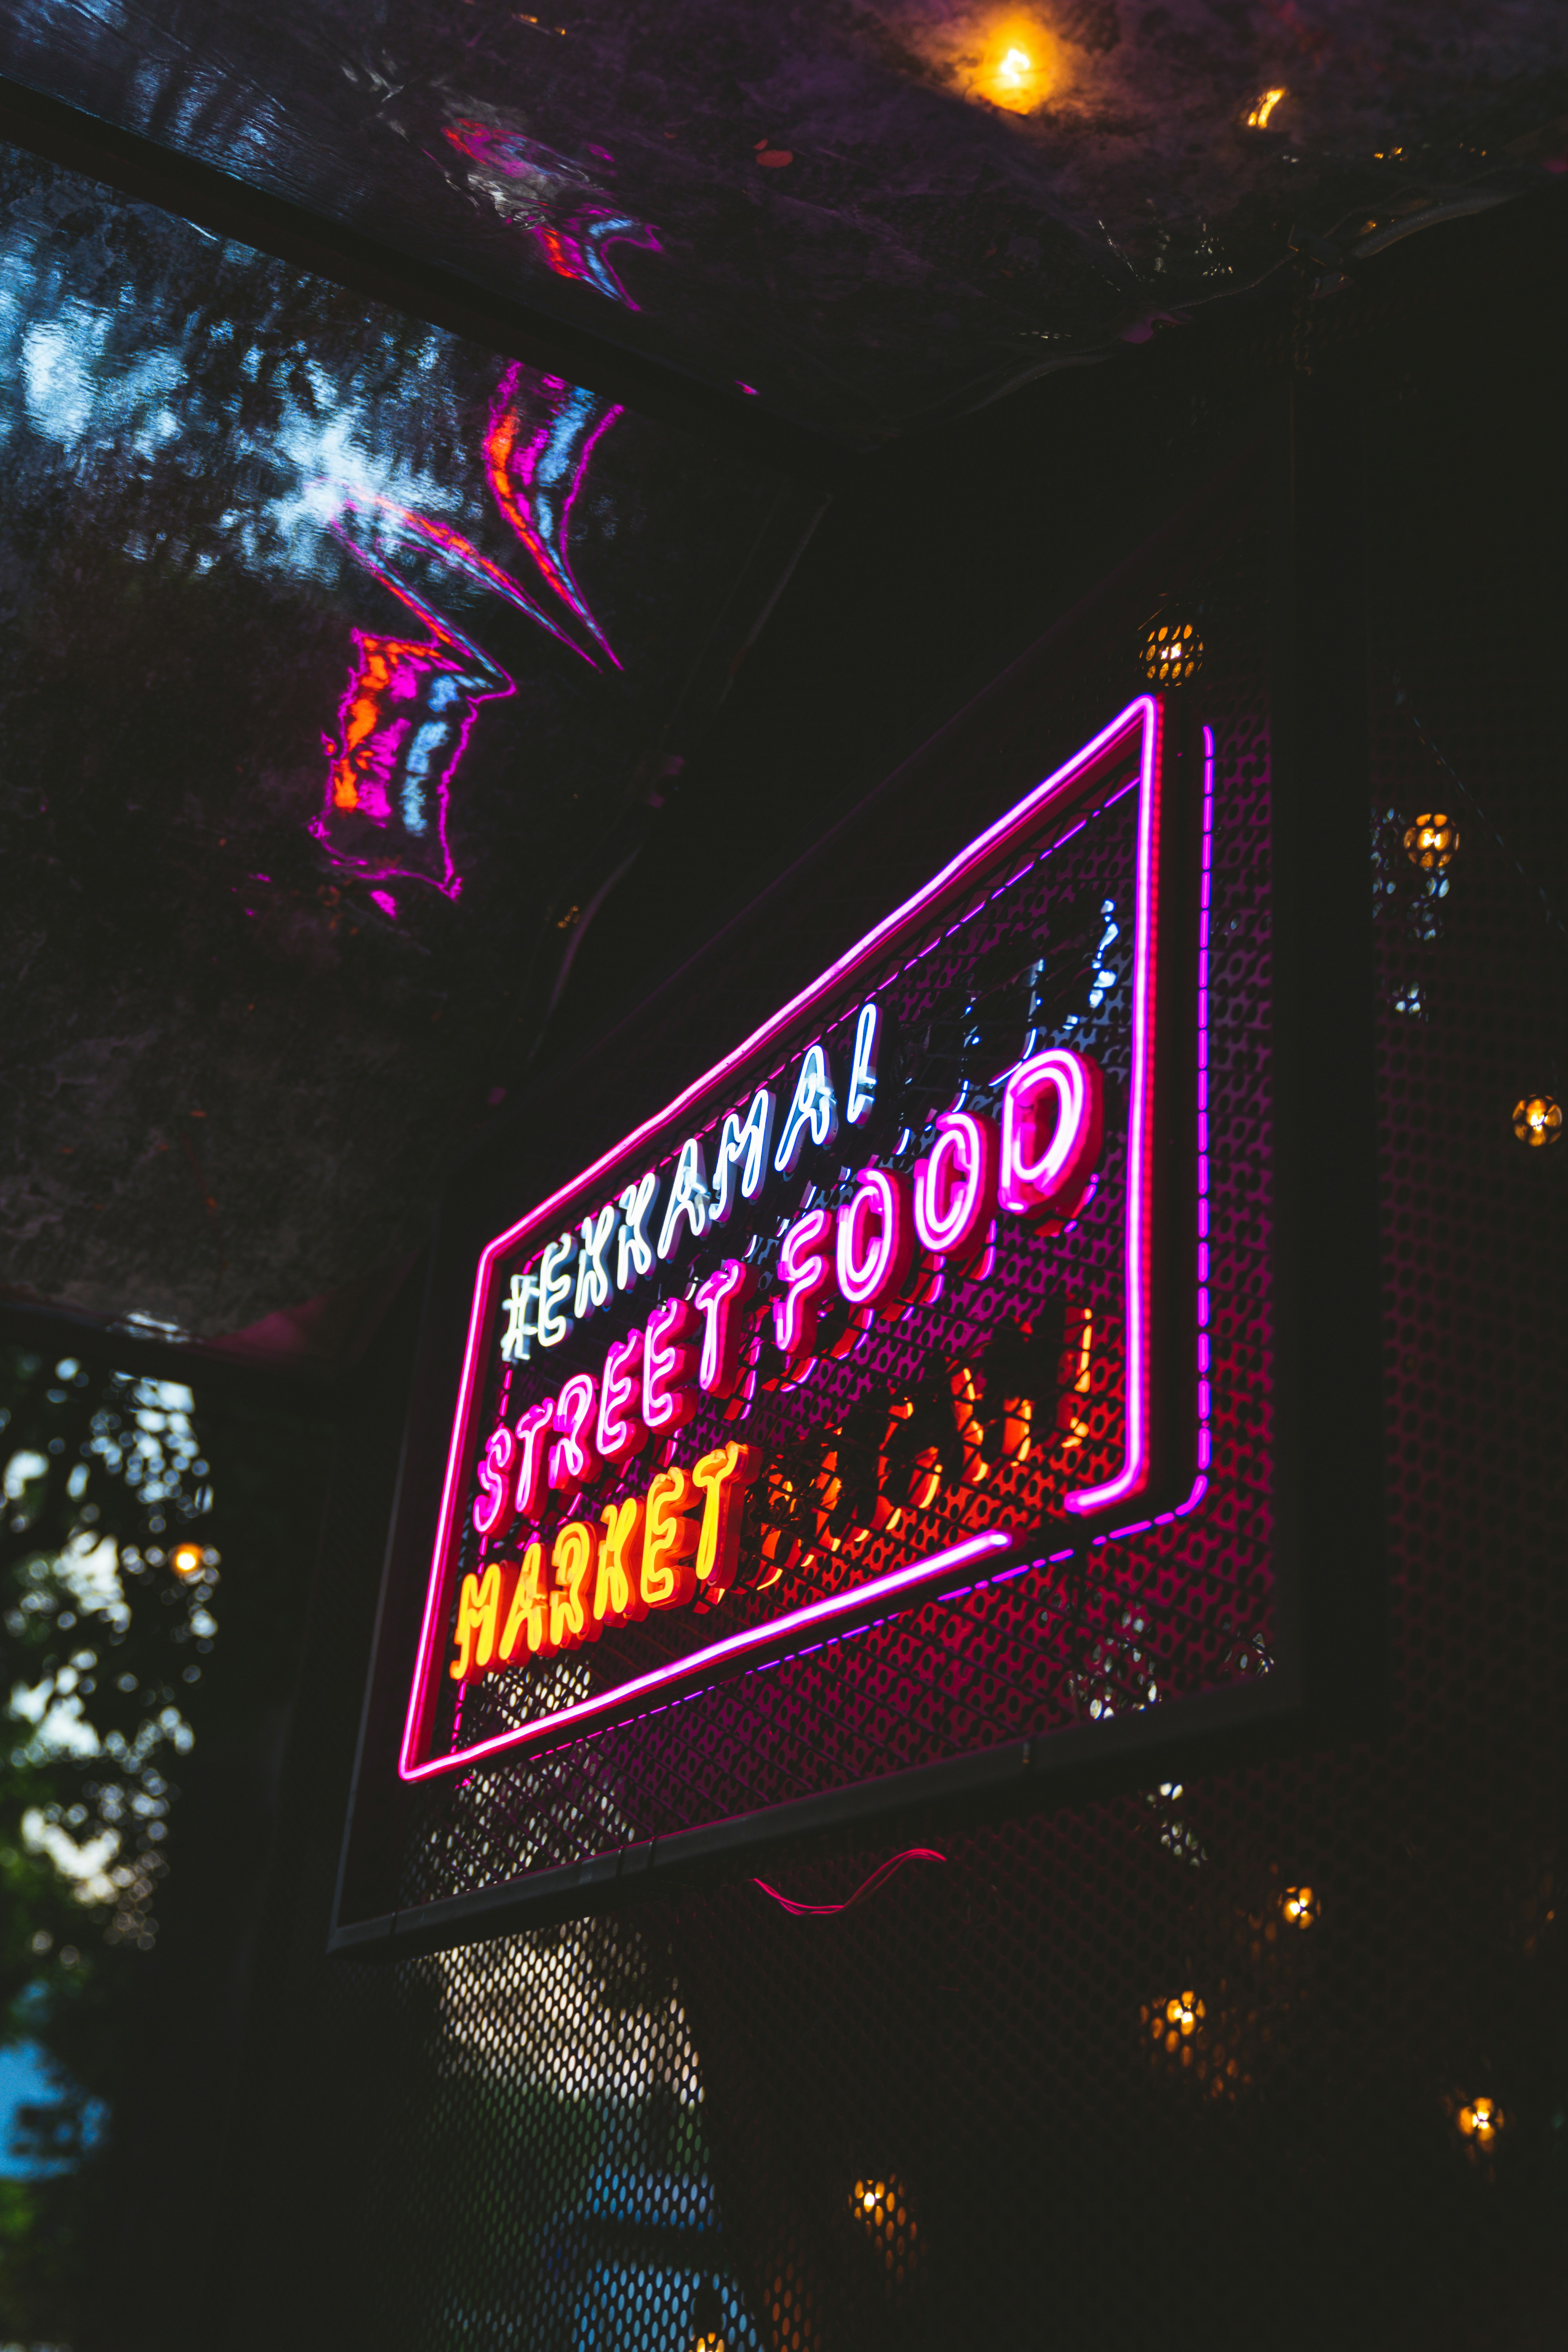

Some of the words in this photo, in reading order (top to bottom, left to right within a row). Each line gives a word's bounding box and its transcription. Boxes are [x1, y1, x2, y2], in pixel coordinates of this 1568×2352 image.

[473, 1258, 744, 1534] STREET
[773, 1047, 1092, 1352] FOOD
[501, 1003, 877, 1363] #EKKAMAI
[449, 1440, 750, 1681] MARKET
